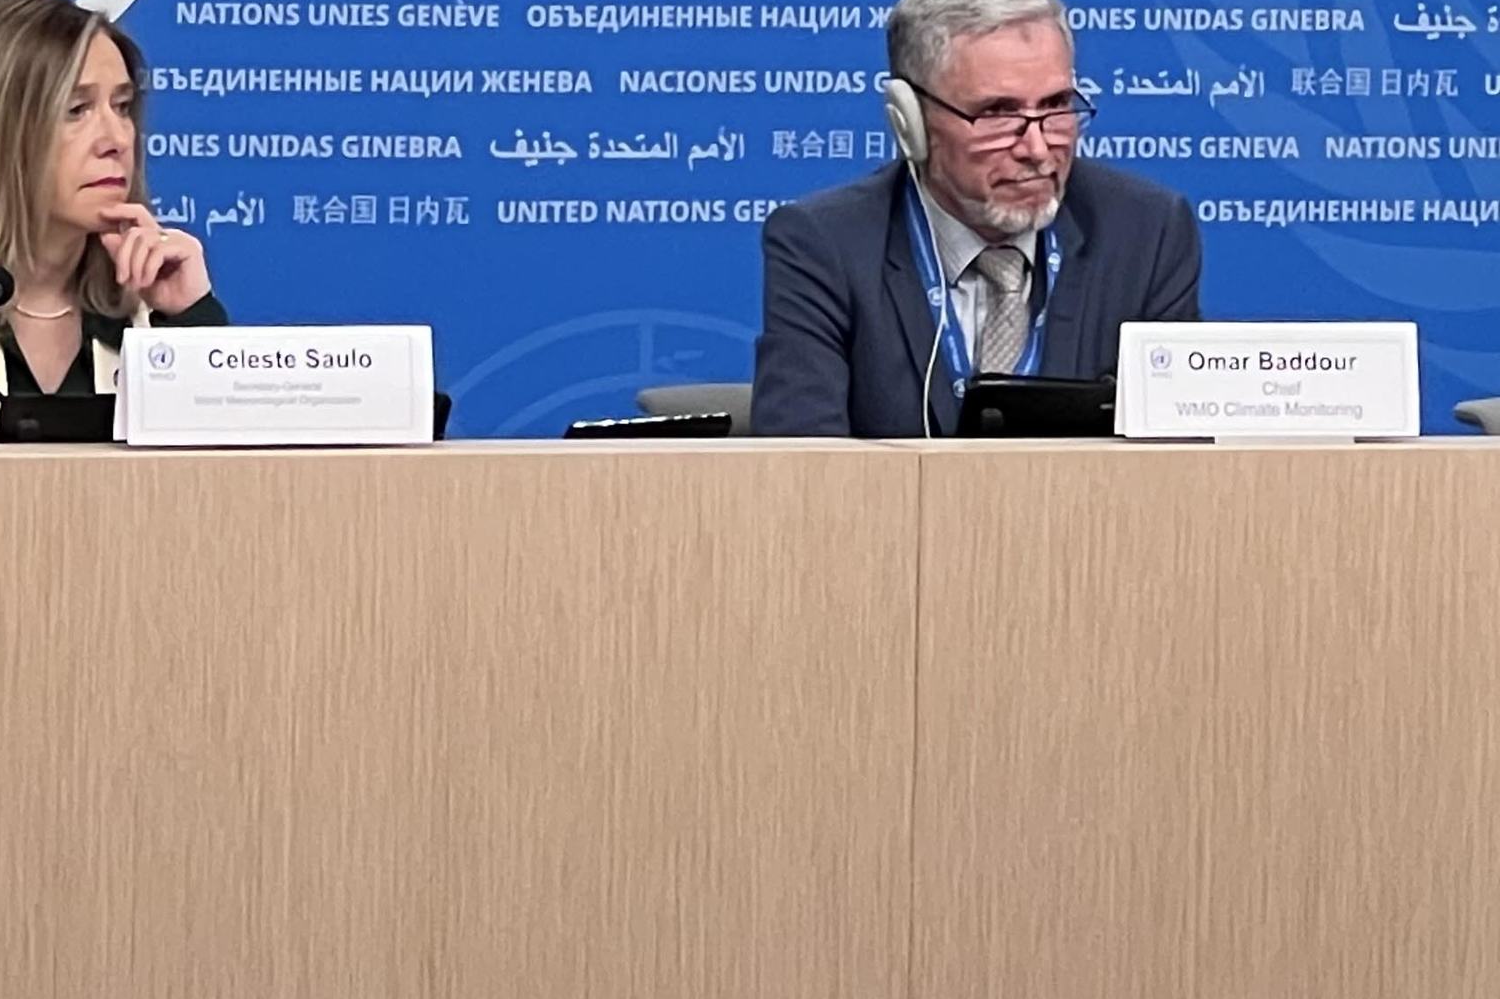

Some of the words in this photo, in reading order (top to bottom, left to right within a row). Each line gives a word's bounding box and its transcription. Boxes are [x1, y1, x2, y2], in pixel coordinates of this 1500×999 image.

[176, 2, 300, 26] NATIONS
[308, 3, 390, 27] UNIES
[526, 4, 753, 34] ОБЪЕДИНЕННЫЕ
[760, 5, 861, 34] НАЦИИ
[1144, 8, 1244, 31] UNIDAS
[1250, 8, 1365, 31] GINEBRA
[1393, 2, 1477, 40] جنيف
[370, 69, 474, 98] НАЦИИ
[481, 70, 593, 93] ЖЕНЕВА
[620, 70, 757, 93] NACIONES
[764, 70, 867, 94] UNIDAS
[1113, 68, 1200, 96] المتحدة
[1209, 65, 1265, 107] الأمم
[1291, 67, 1371, 97] 联合国
[1381, 69, 1458, 97] 日内瓦
[228, 134, 334, 158] UNIDAS
[341, 135, 462, 158] GINEBRA
[489, 128, 578, 168] جنيف
[588, 131, 678, 159] المتحدة
[687, 127, 745, 171] الأمم
[772, 130, 854, 159] 联合国
[1199, 136, 1300, 159] GENEVA
[1325, 136, 1441, 159] NATIONS
[206, 191, 265, 237] الأمم
[293, 195, 377, 224] 联合国
[389, 195, 469, 225] 日内瓦
[497, 200, 598, 224] UNITED
[606, 199, 726, 223] NATIONS
[1198, 199, 1415, 228] ОБЪЕДИНЕННЫЕ
[208, 348, 296, 369] Celeste
[305, 348, 372, 369] Saulo
[1188, 351, 1251, 371] Omar
[1259, 351, 1357, 371] Baddour
[1176, 402, 1219, 416] WMO
